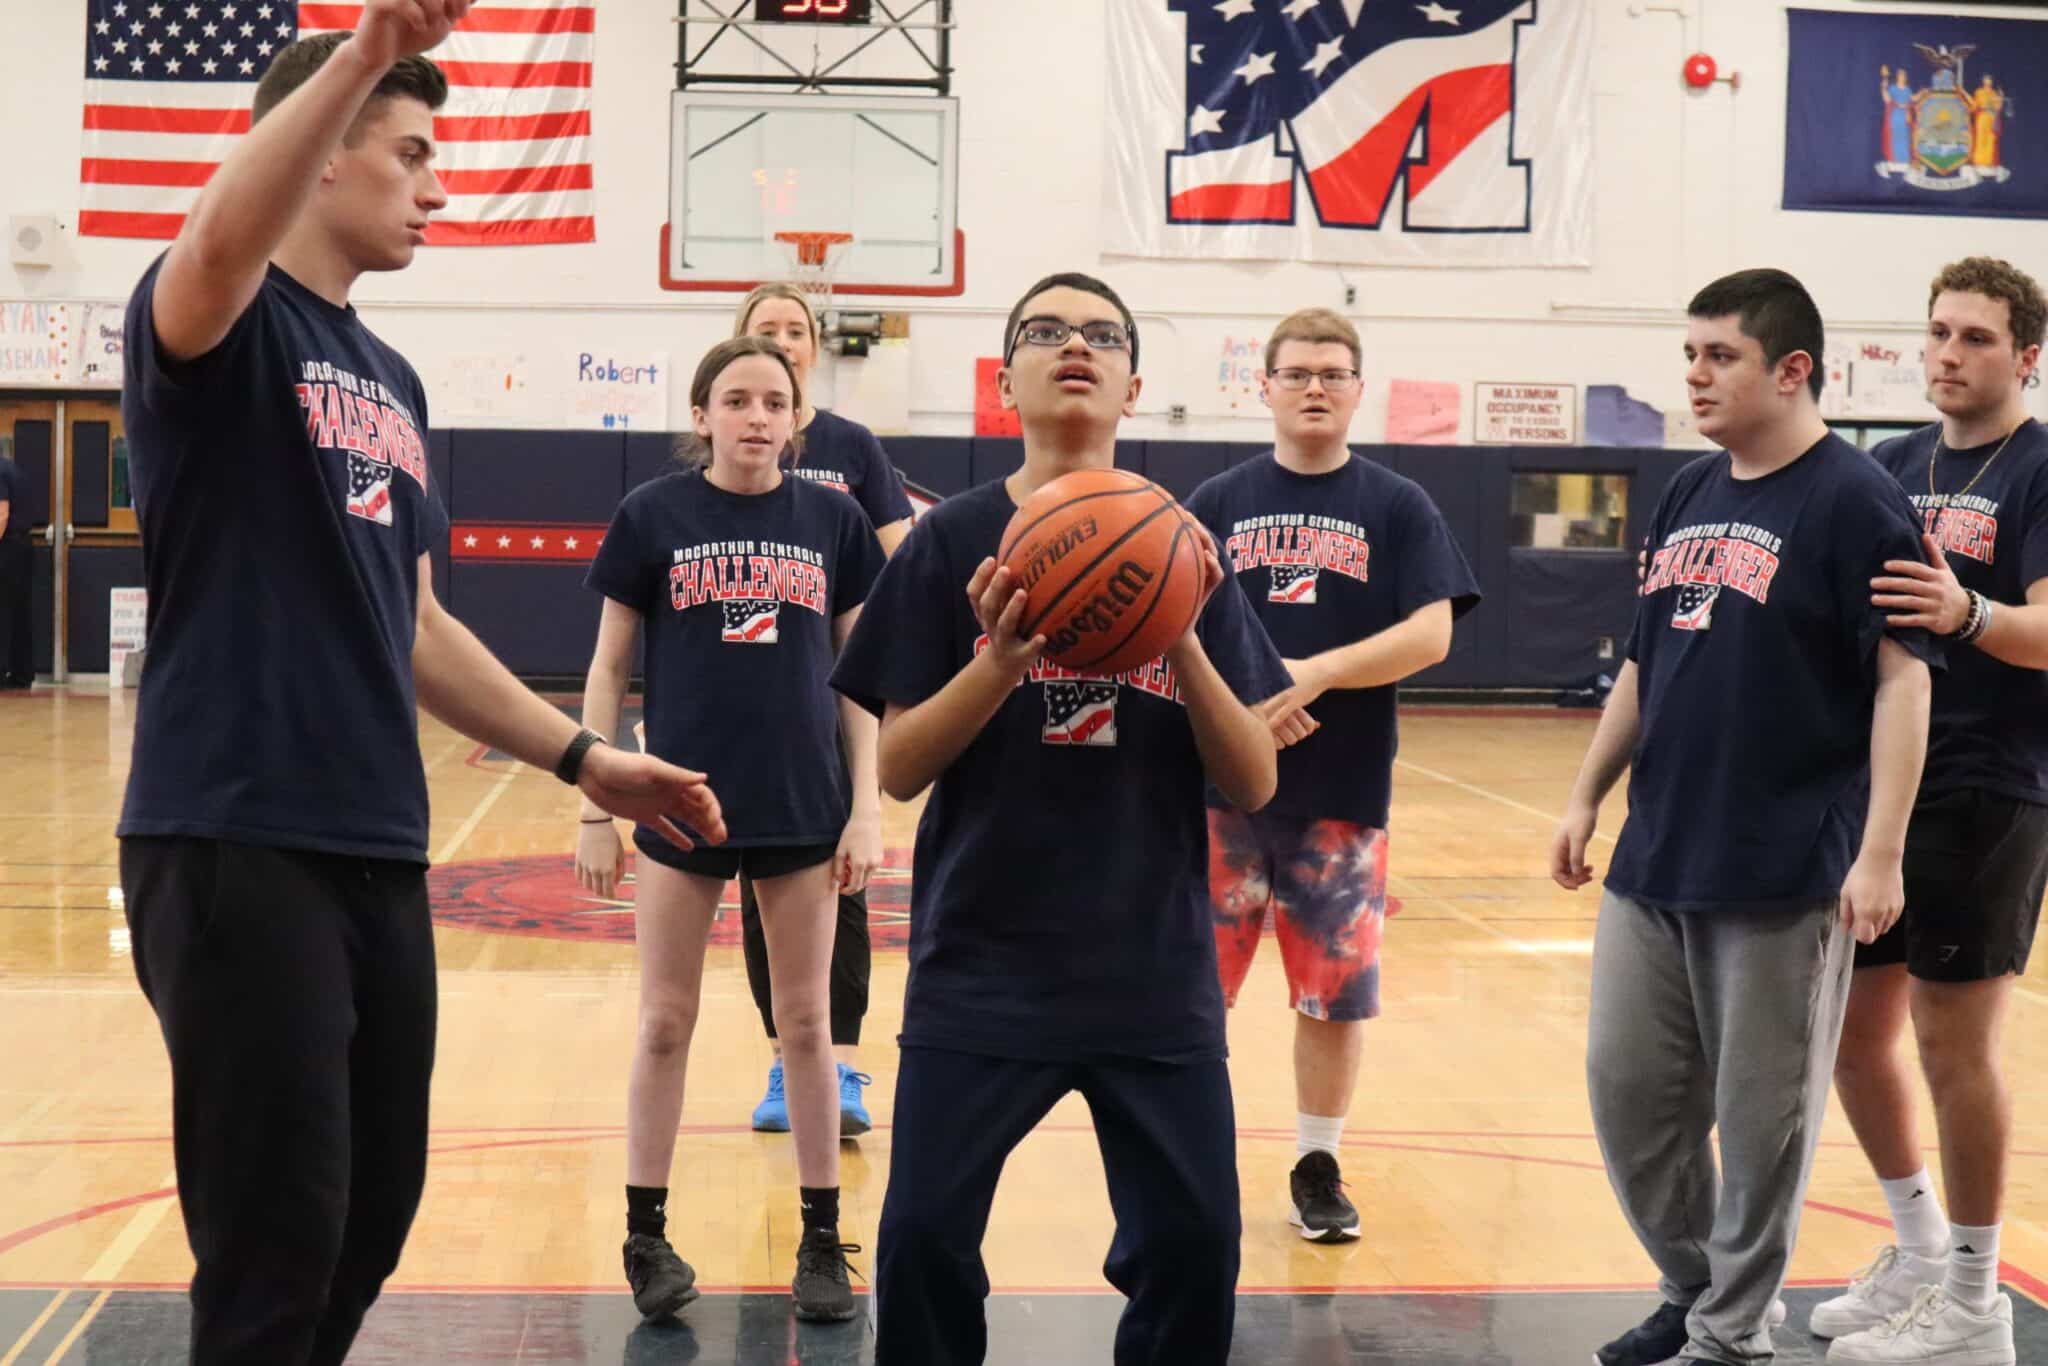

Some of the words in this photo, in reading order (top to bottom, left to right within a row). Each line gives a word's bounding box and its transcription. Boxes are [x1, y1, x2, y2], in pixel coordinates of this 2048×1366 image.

[579, 352, 658, 385] Robert
[1487, 402, 1563, 414] OCCUPANCY
[1493, 387, 1558, 400] MAXIMUM
[1509, 427, 1568, 440] PERSONS
[1233, 514, 1304, 534] MACARTHUR
[1308, 514, 1366, 540] GENERALS
[1729, 521, 1782, 554] GENERALS
[1917, 507, 1997, 565] LENGER
[674, 540, 754, 564] MACARTHUR
[760, 540, 823, 567] GENERALS
[1020, 516, 1098, 592] EVOLUT
[1226, 526, 1370, 583] CHALLENGER
[669, 555, 827, 616] CHALLENGER
[1644, 537, 1779, 605] CHALLENGER
